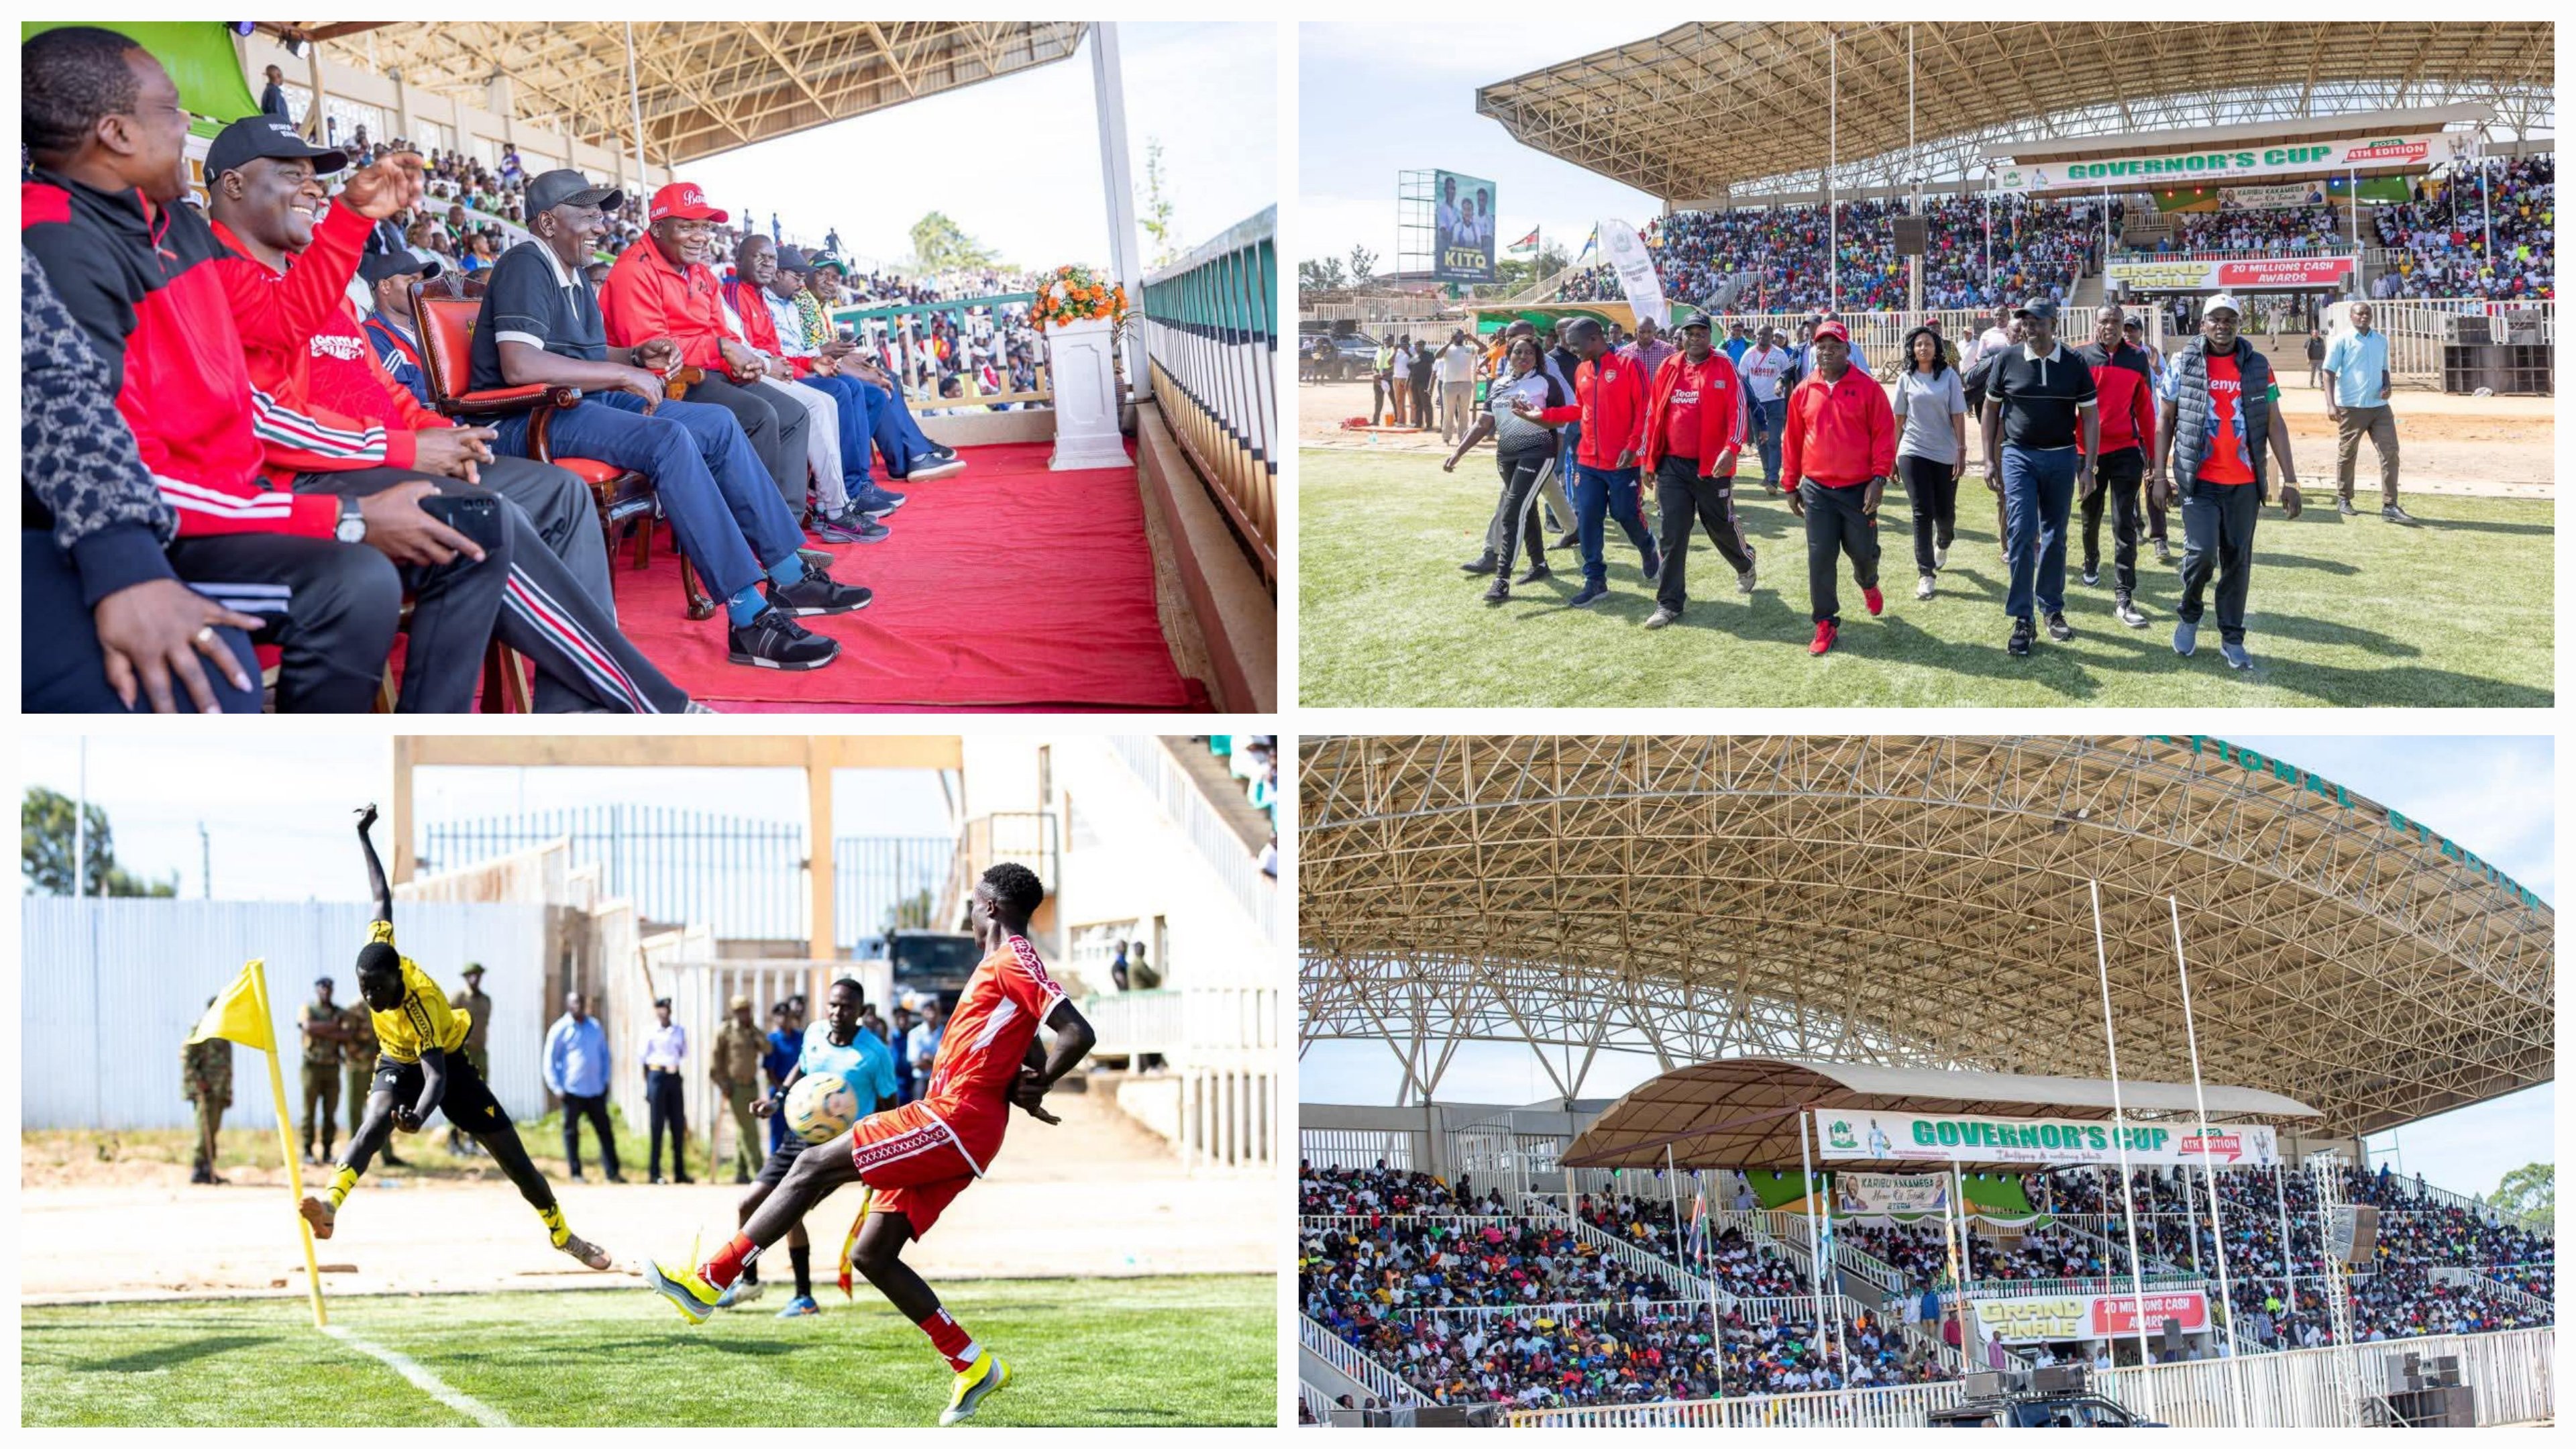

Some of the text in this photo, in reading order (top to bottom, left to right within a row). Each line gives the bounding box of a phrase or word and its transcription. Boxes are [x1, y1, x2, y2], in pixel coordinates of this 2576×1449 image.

[2373, 139, 2400, 147] 2025
[2349, 144, 2424, 158] 4TH EDITION
[2068, 151, 2256, 180] GOVERNOR'S
[2264, 146, 2332, 166] CUP
[2265, 185, 2305, 195] KAKAMEGA
[2110, 263, 2210, 278] GRAND
[2232, 261, 2334, 273] 20 MILLIONS CASH
[2258, 272, 2307, 283] AWARDS
[1674, 388, 1699, 397] Team
[2208, 378, 2241, 393] eny
[2387, 809, 2539, 914] STADIUM
[1912, 1119, 2169, 1151] GOVERNOR'S CUP
[2183, 1138, 2238, 1149] 4TH DITION
[1861, 1177, 1935, 1188] KARIBU KAKAMEGA
[1980, 1299, 2084, 1324] GRAND
[2104, 1297, 2190, 1313] 20 MILONS CASH
[1992, 1318, 2078, 1340] FINALE
